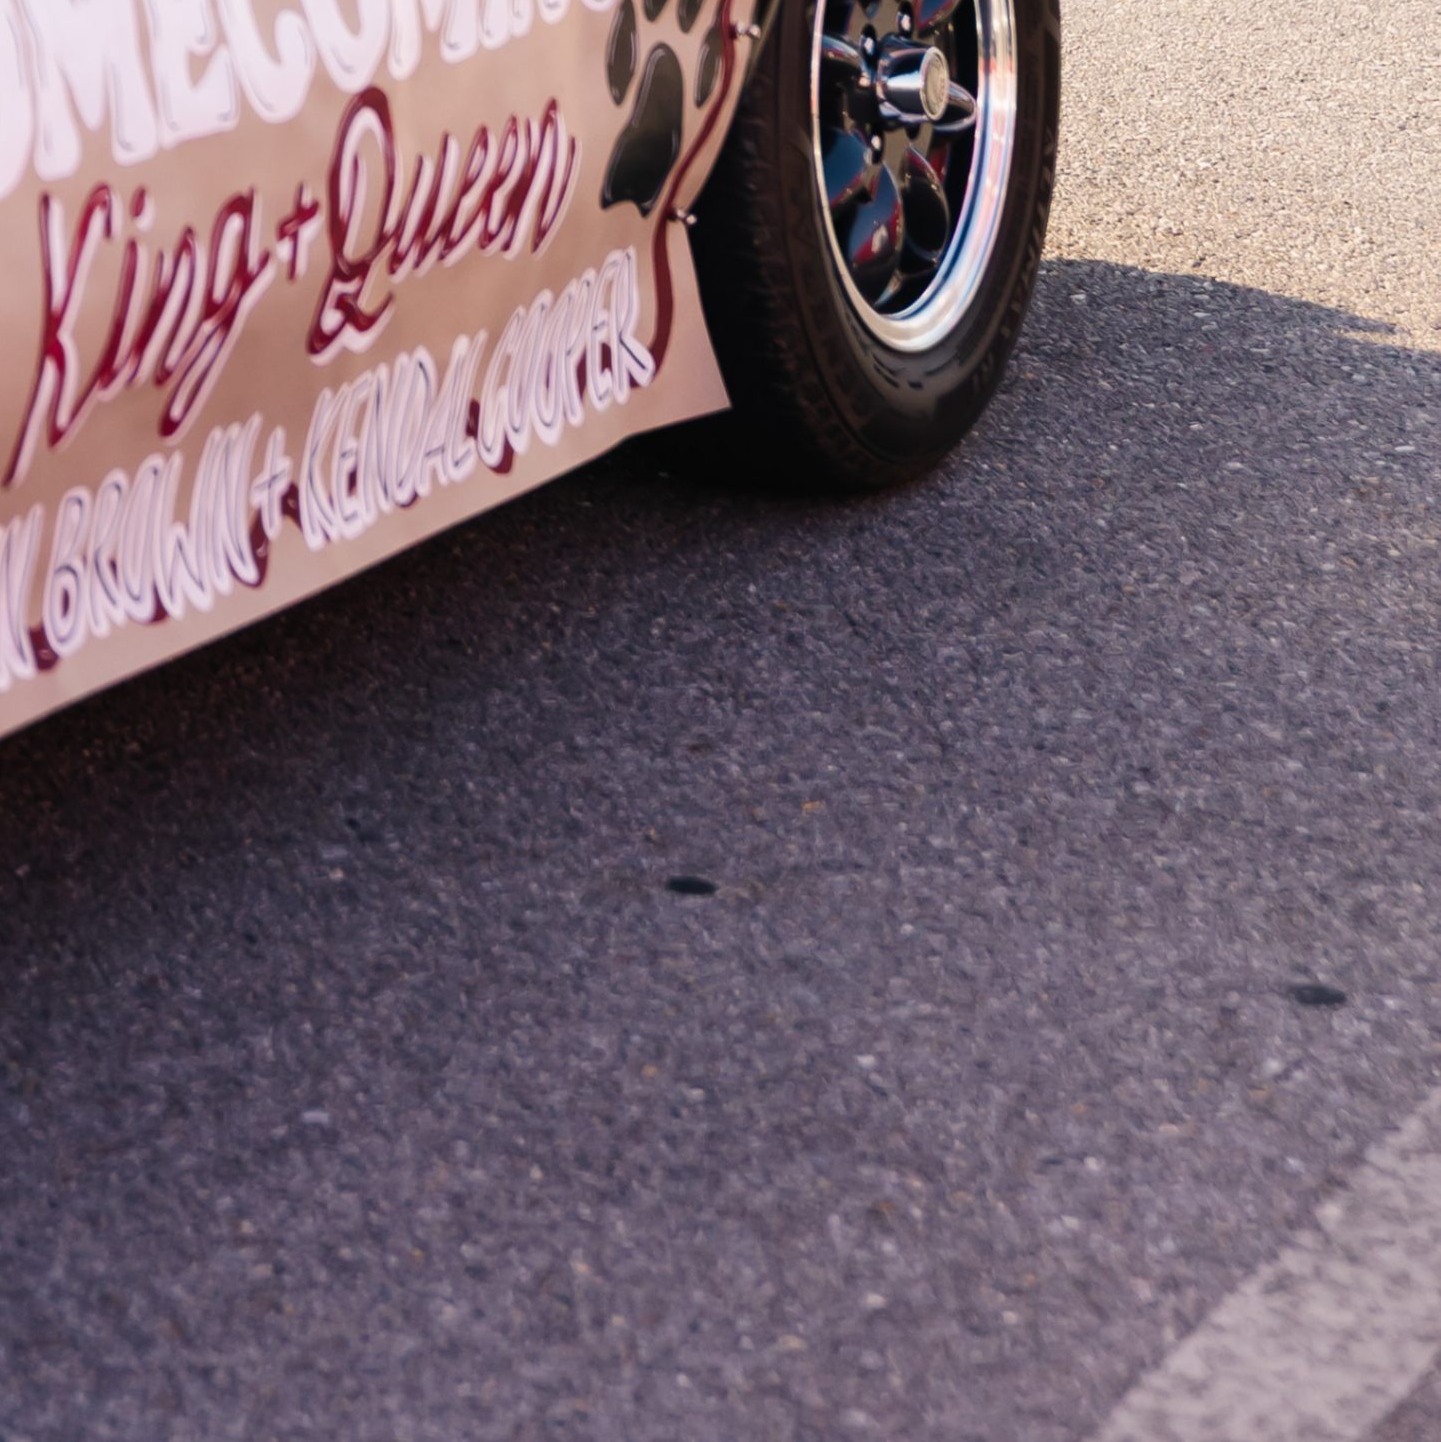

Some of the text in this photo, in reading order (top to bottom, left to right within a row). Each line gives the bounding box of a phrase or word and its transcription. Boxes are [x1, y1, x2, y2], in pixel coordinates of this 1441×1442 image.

[3, 86, 583, 488] King + Queen
[43, 412, 263, 657] BROWN
[250, 425, 293, 541] +
[299, 330, 488, 552] KENDAL
[476, 245, 656, 467] COOPER
